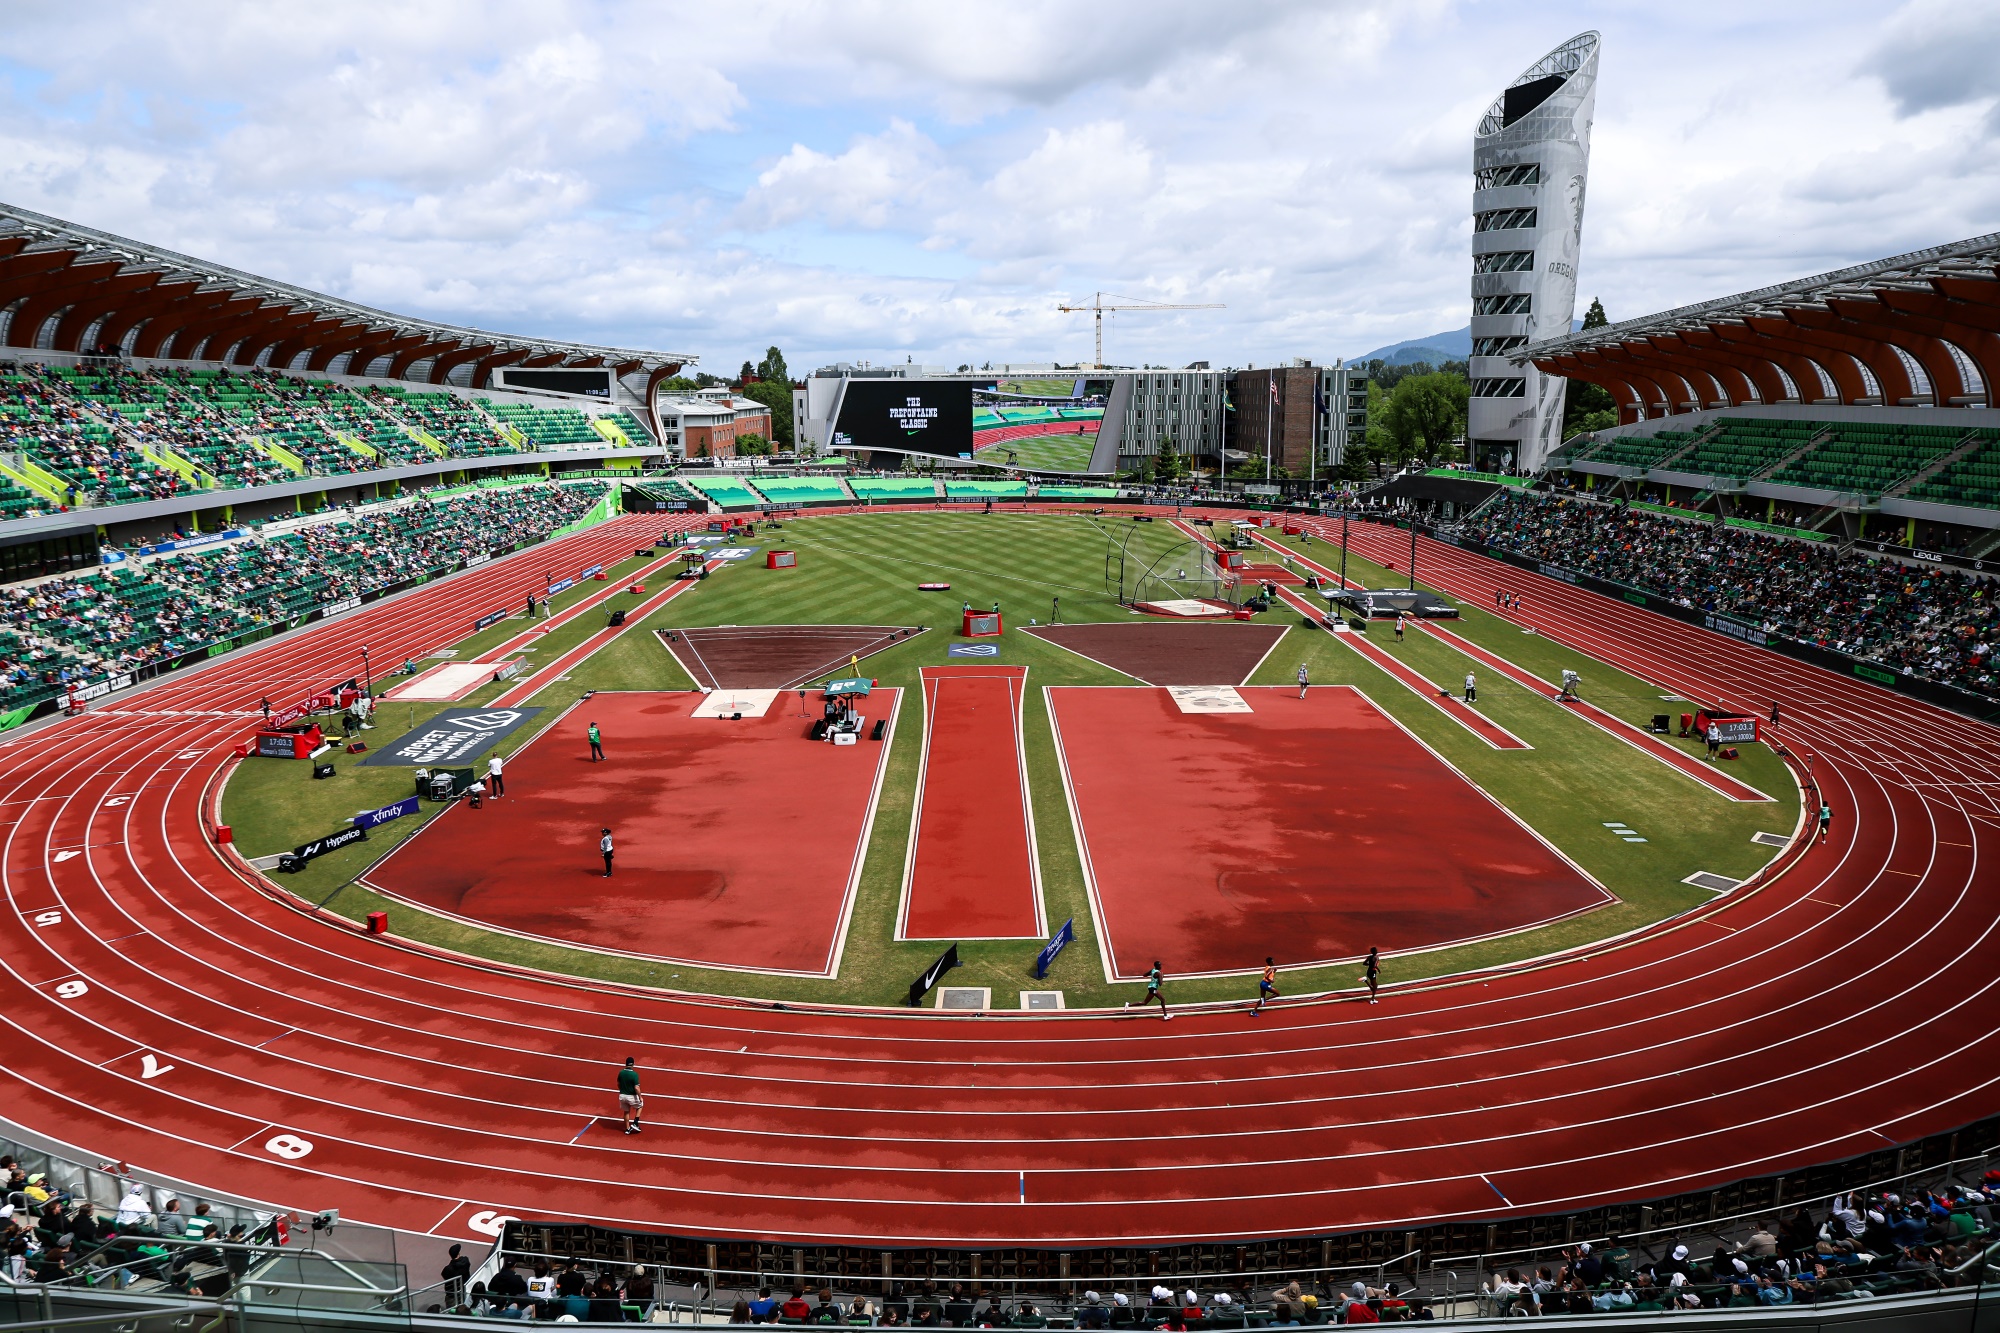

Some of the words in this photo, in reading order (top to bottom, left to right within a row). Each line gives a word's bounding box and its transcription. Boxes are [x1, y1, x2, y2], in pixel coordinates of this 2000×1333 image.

[906, 397, 921, 407] THE
[889, 408, 938, 418] PREFONTAINE
[900, 419, 928, 428] CLASSIC
[1912, 550, 1942, 562] LEXUS
[1705, 615, 1715, 628] THE
[1715, 618, 1747, 639] PREFONTAINE
[1747, 628, 1767, 646] CLASSIC
[281, 709, 298, 723] OMEGA
[1729, 723, 1753, 731] 17:03.3
[269, 738, 293, 746] 17:03.3
[396, 729, 447, 757] LEAGUE
[412, 731, 474, 763] DIAMOND
[104, 796, 131, 806] 3
[372, 805, 403, 823] xfinity
[326, 828, 361, 848] Hyperice
[53, 850, 82, 863] 4
[34, 911, 62, 927] 5
[55, 980, 89, 999] 6
[140, 1053, 175, 1079] 7
[265, 1134, 314, 1160] 8
[468, 1210, 522, 1237] 9
